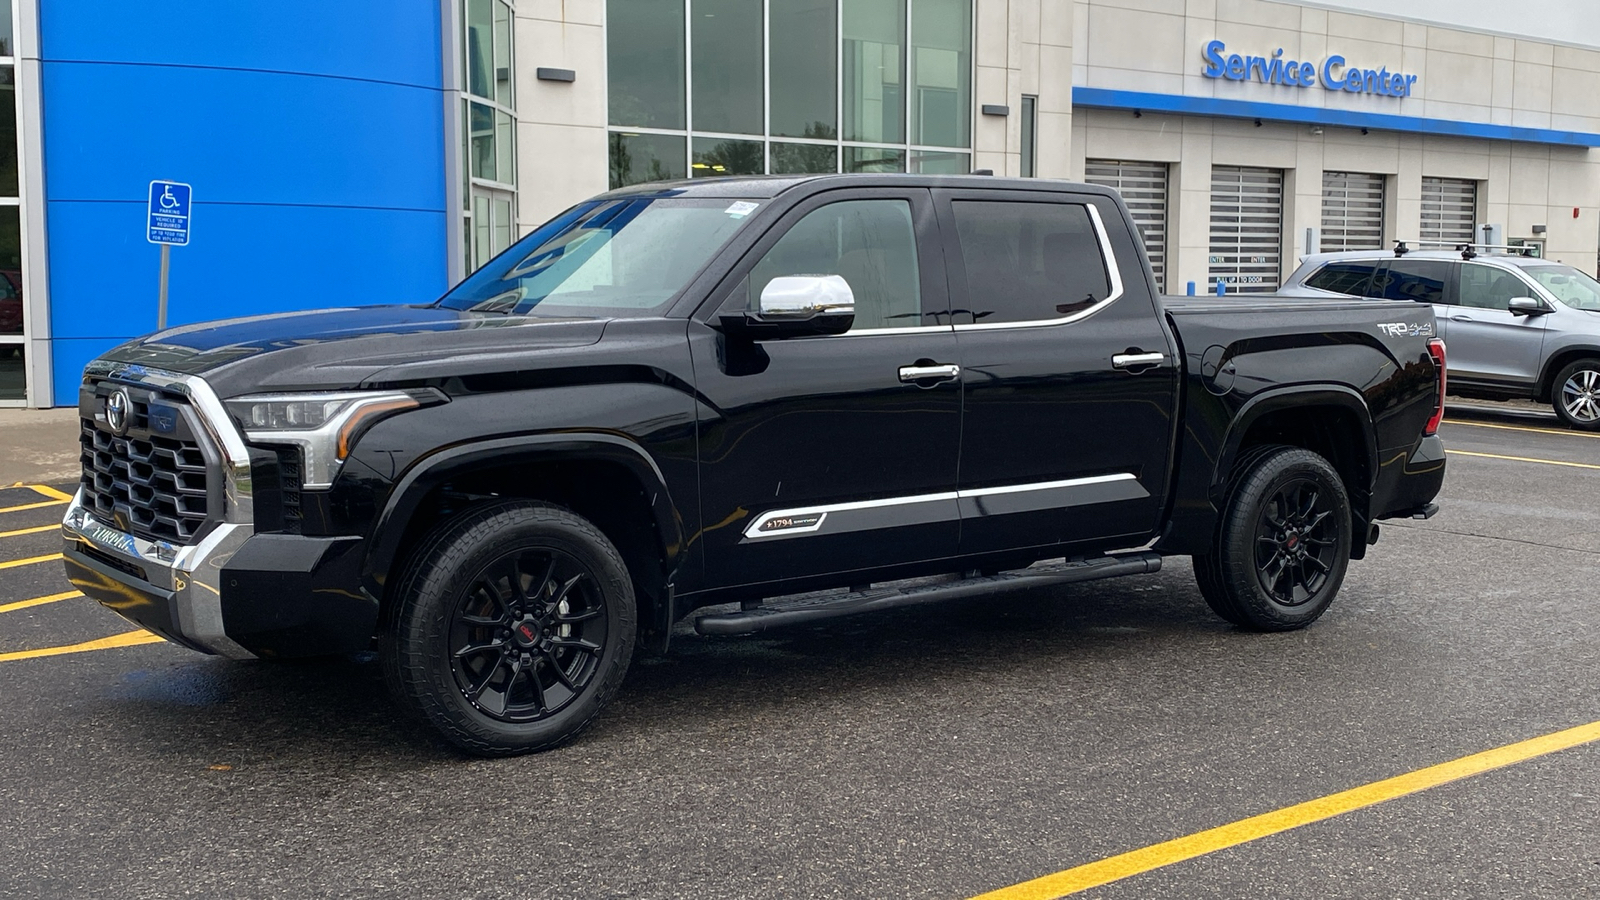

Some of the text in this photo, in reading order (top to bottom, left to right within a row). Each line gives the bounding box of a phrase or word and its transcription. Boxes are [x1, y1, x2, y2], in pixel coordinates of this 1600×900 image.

[1203, 40, 1418, 97] Service Center
[1377, 322, 1408, 336] TRD
[773, 518, 793, 528] 1794
